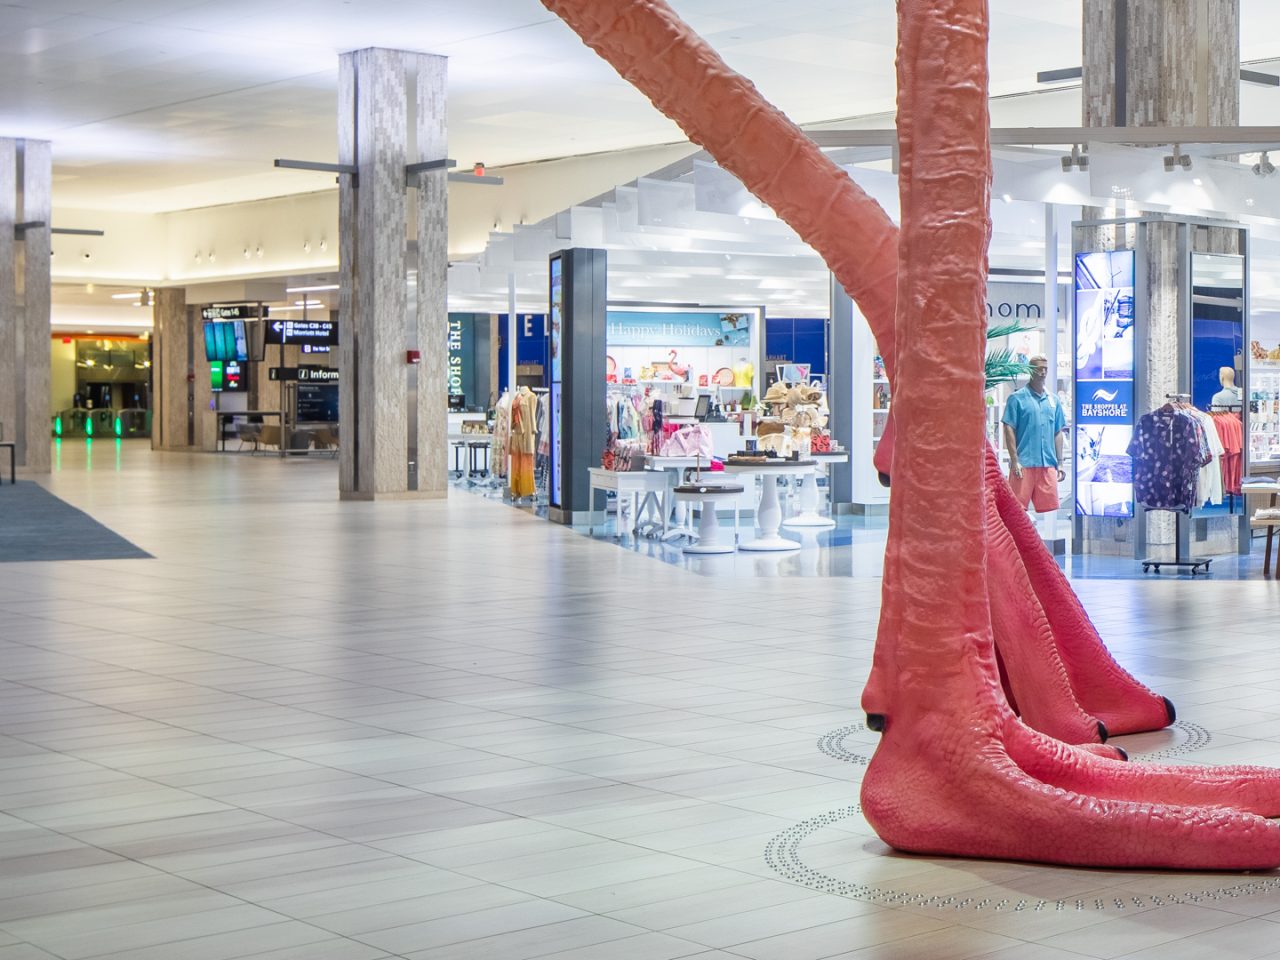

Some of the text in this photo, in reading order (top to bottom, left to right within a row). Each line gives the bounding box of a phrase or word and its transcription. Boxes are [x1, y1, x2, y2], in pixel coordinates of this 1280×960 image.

[450, 321, 461, 350] THE
[610, 322, 721, 339] Happy Holidays
[310, 369, 339, 379] Inform
[1082, 409, 1127, 417] BAYSHORE
